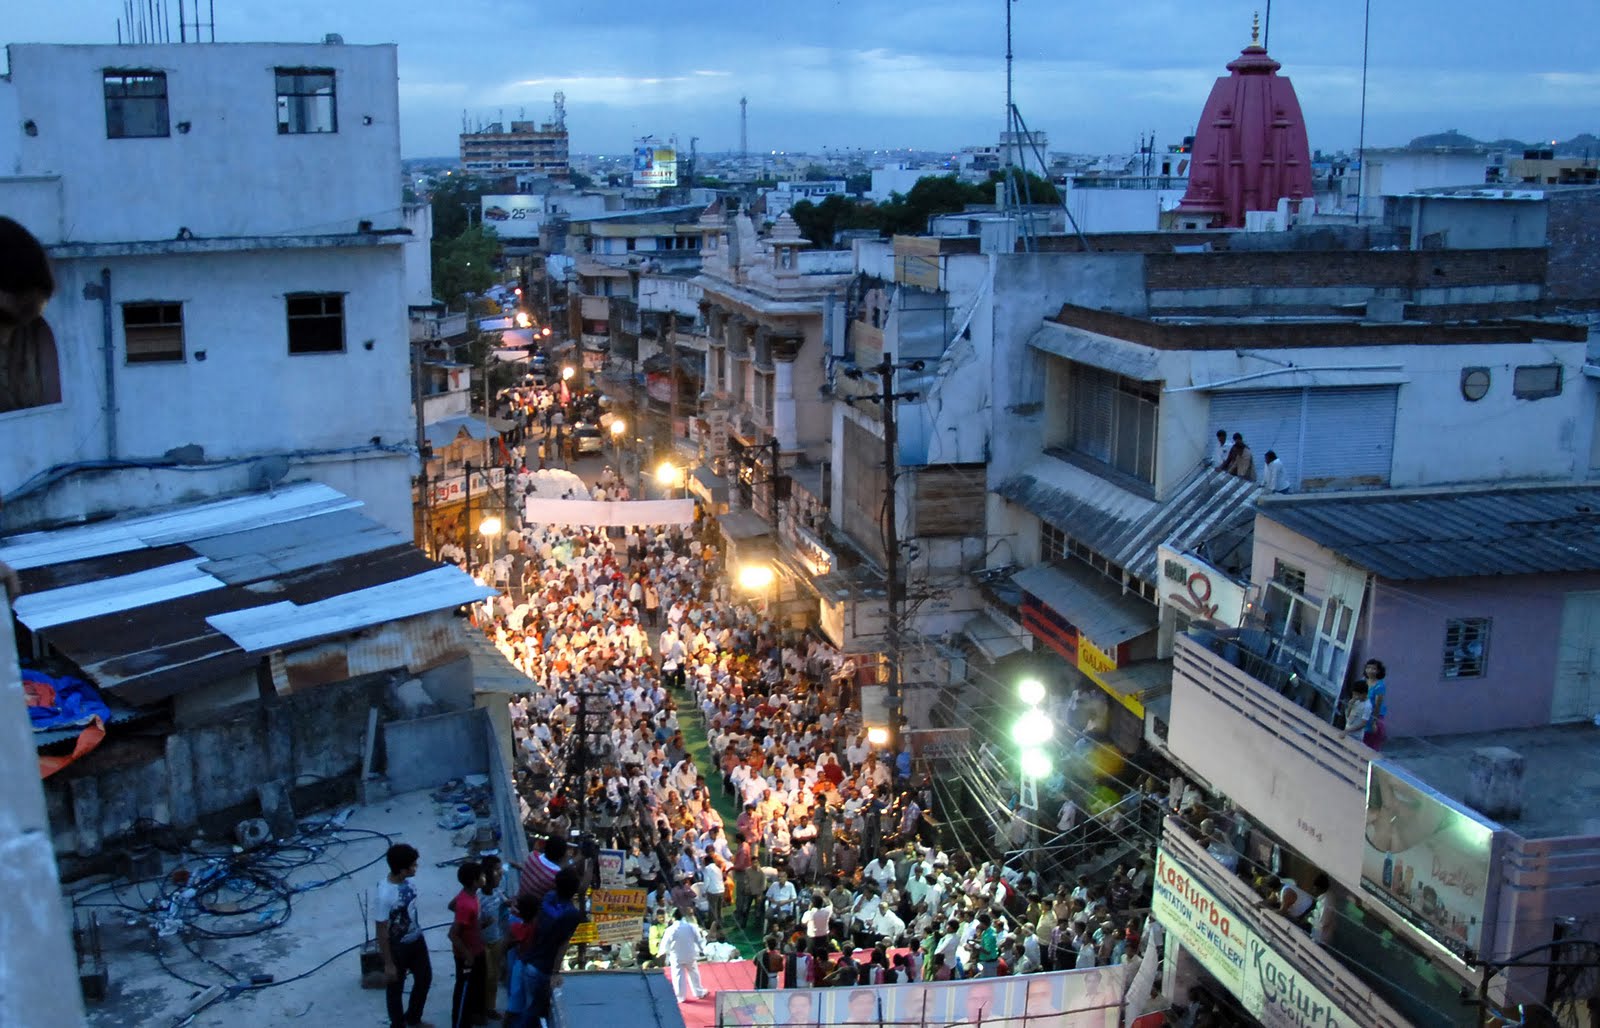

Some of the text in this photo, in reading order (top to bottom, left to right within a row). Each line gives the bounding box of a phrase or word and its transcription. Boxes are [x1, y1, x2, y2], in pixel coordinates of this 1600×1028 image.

[512, 208, 526, 220] 25
[1158, 853, 1230, 937] Kasturba
[1195, 920, 1244, 969] JEWELLERY
